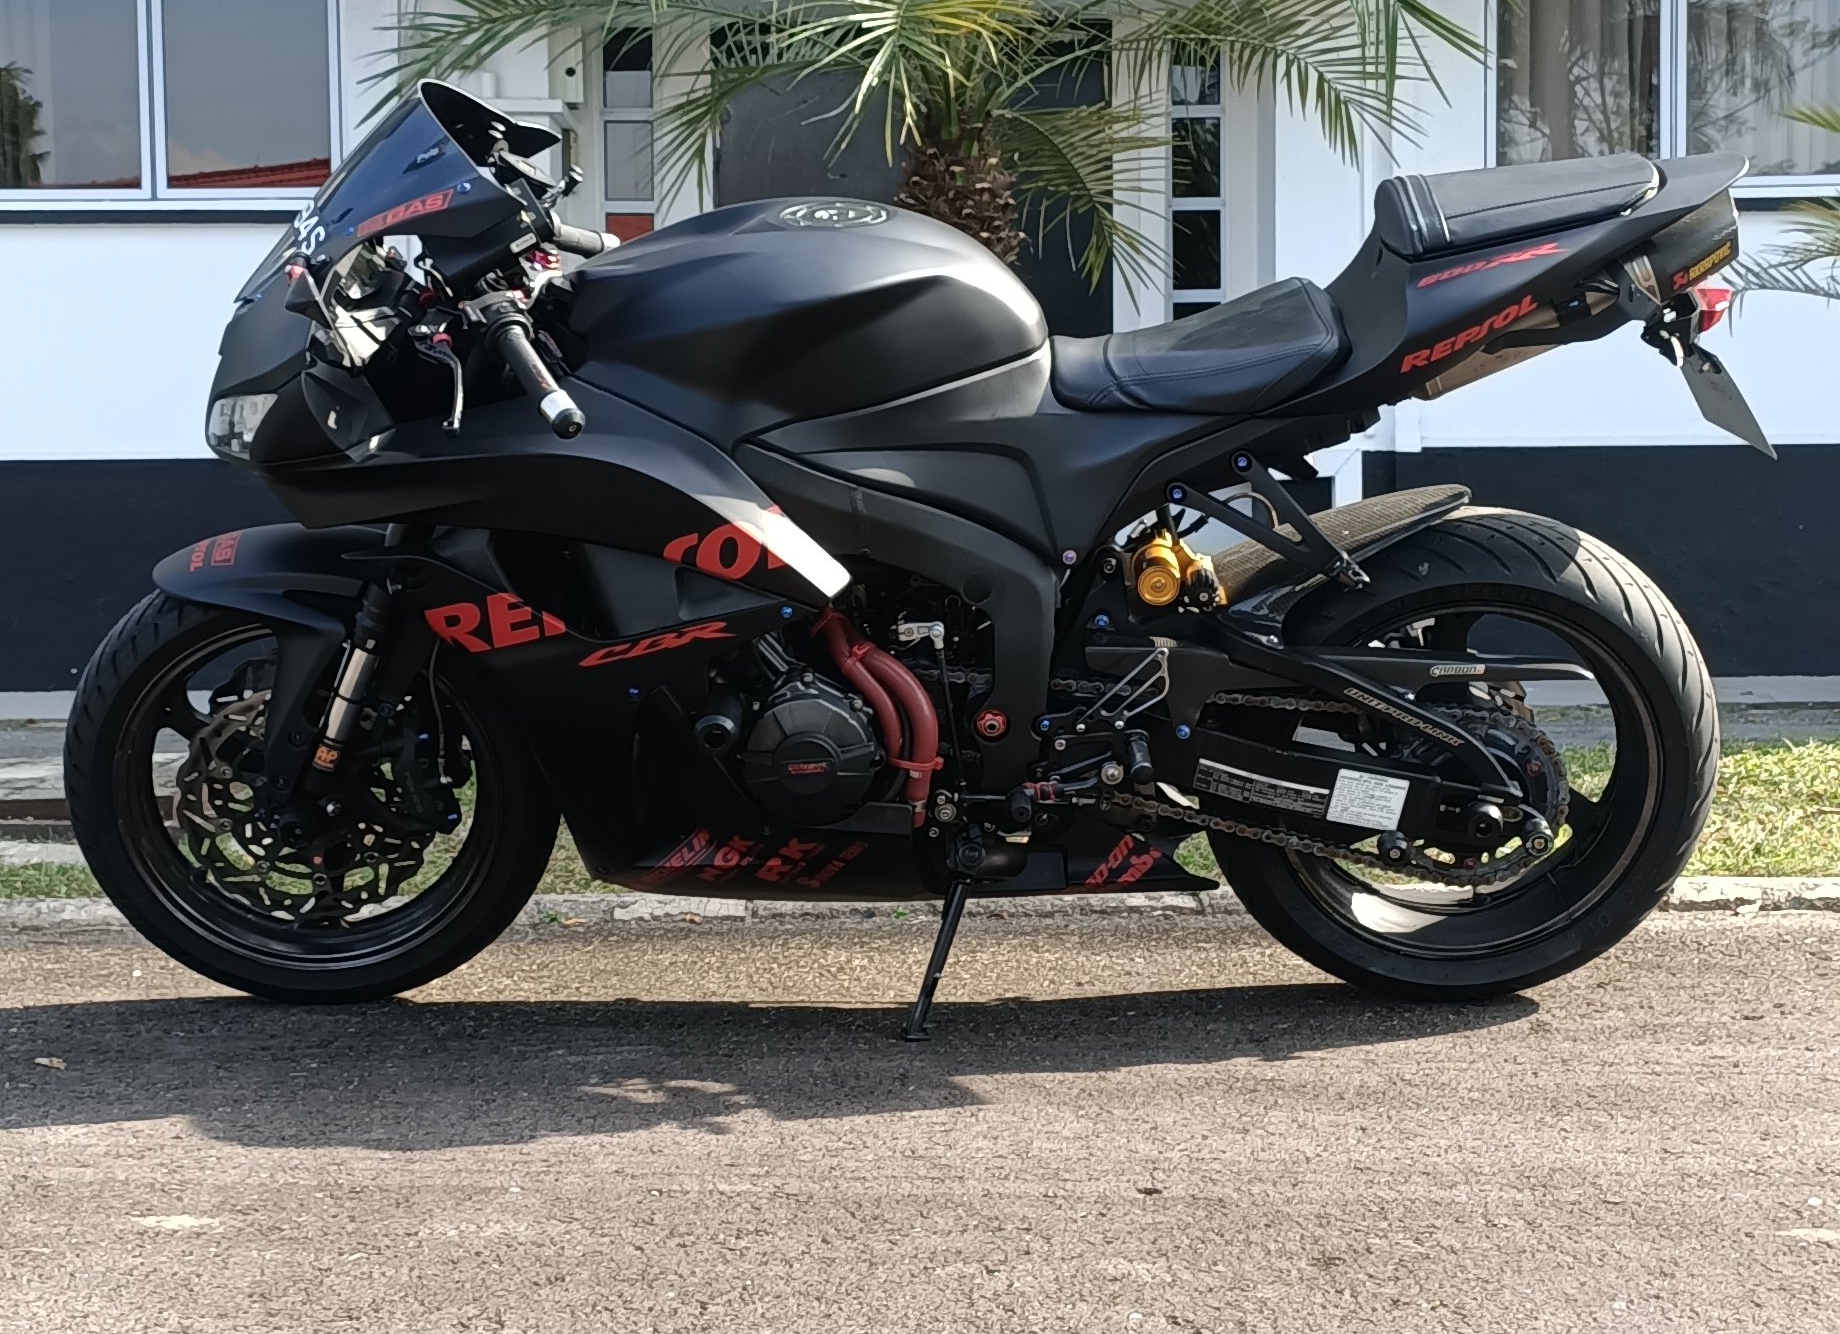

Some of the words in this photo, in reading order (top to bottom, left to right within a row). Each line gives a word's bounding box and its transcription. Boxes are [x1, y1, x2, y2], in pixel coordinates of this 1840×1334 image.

[384, 193, 444, 224] GAS
[1400, 294, 1538, 373] REPSOL
[578, 621, 737, 667] CBR
[696, 835, 755, 882] NGK
[756, 837, 819, 883] RK
